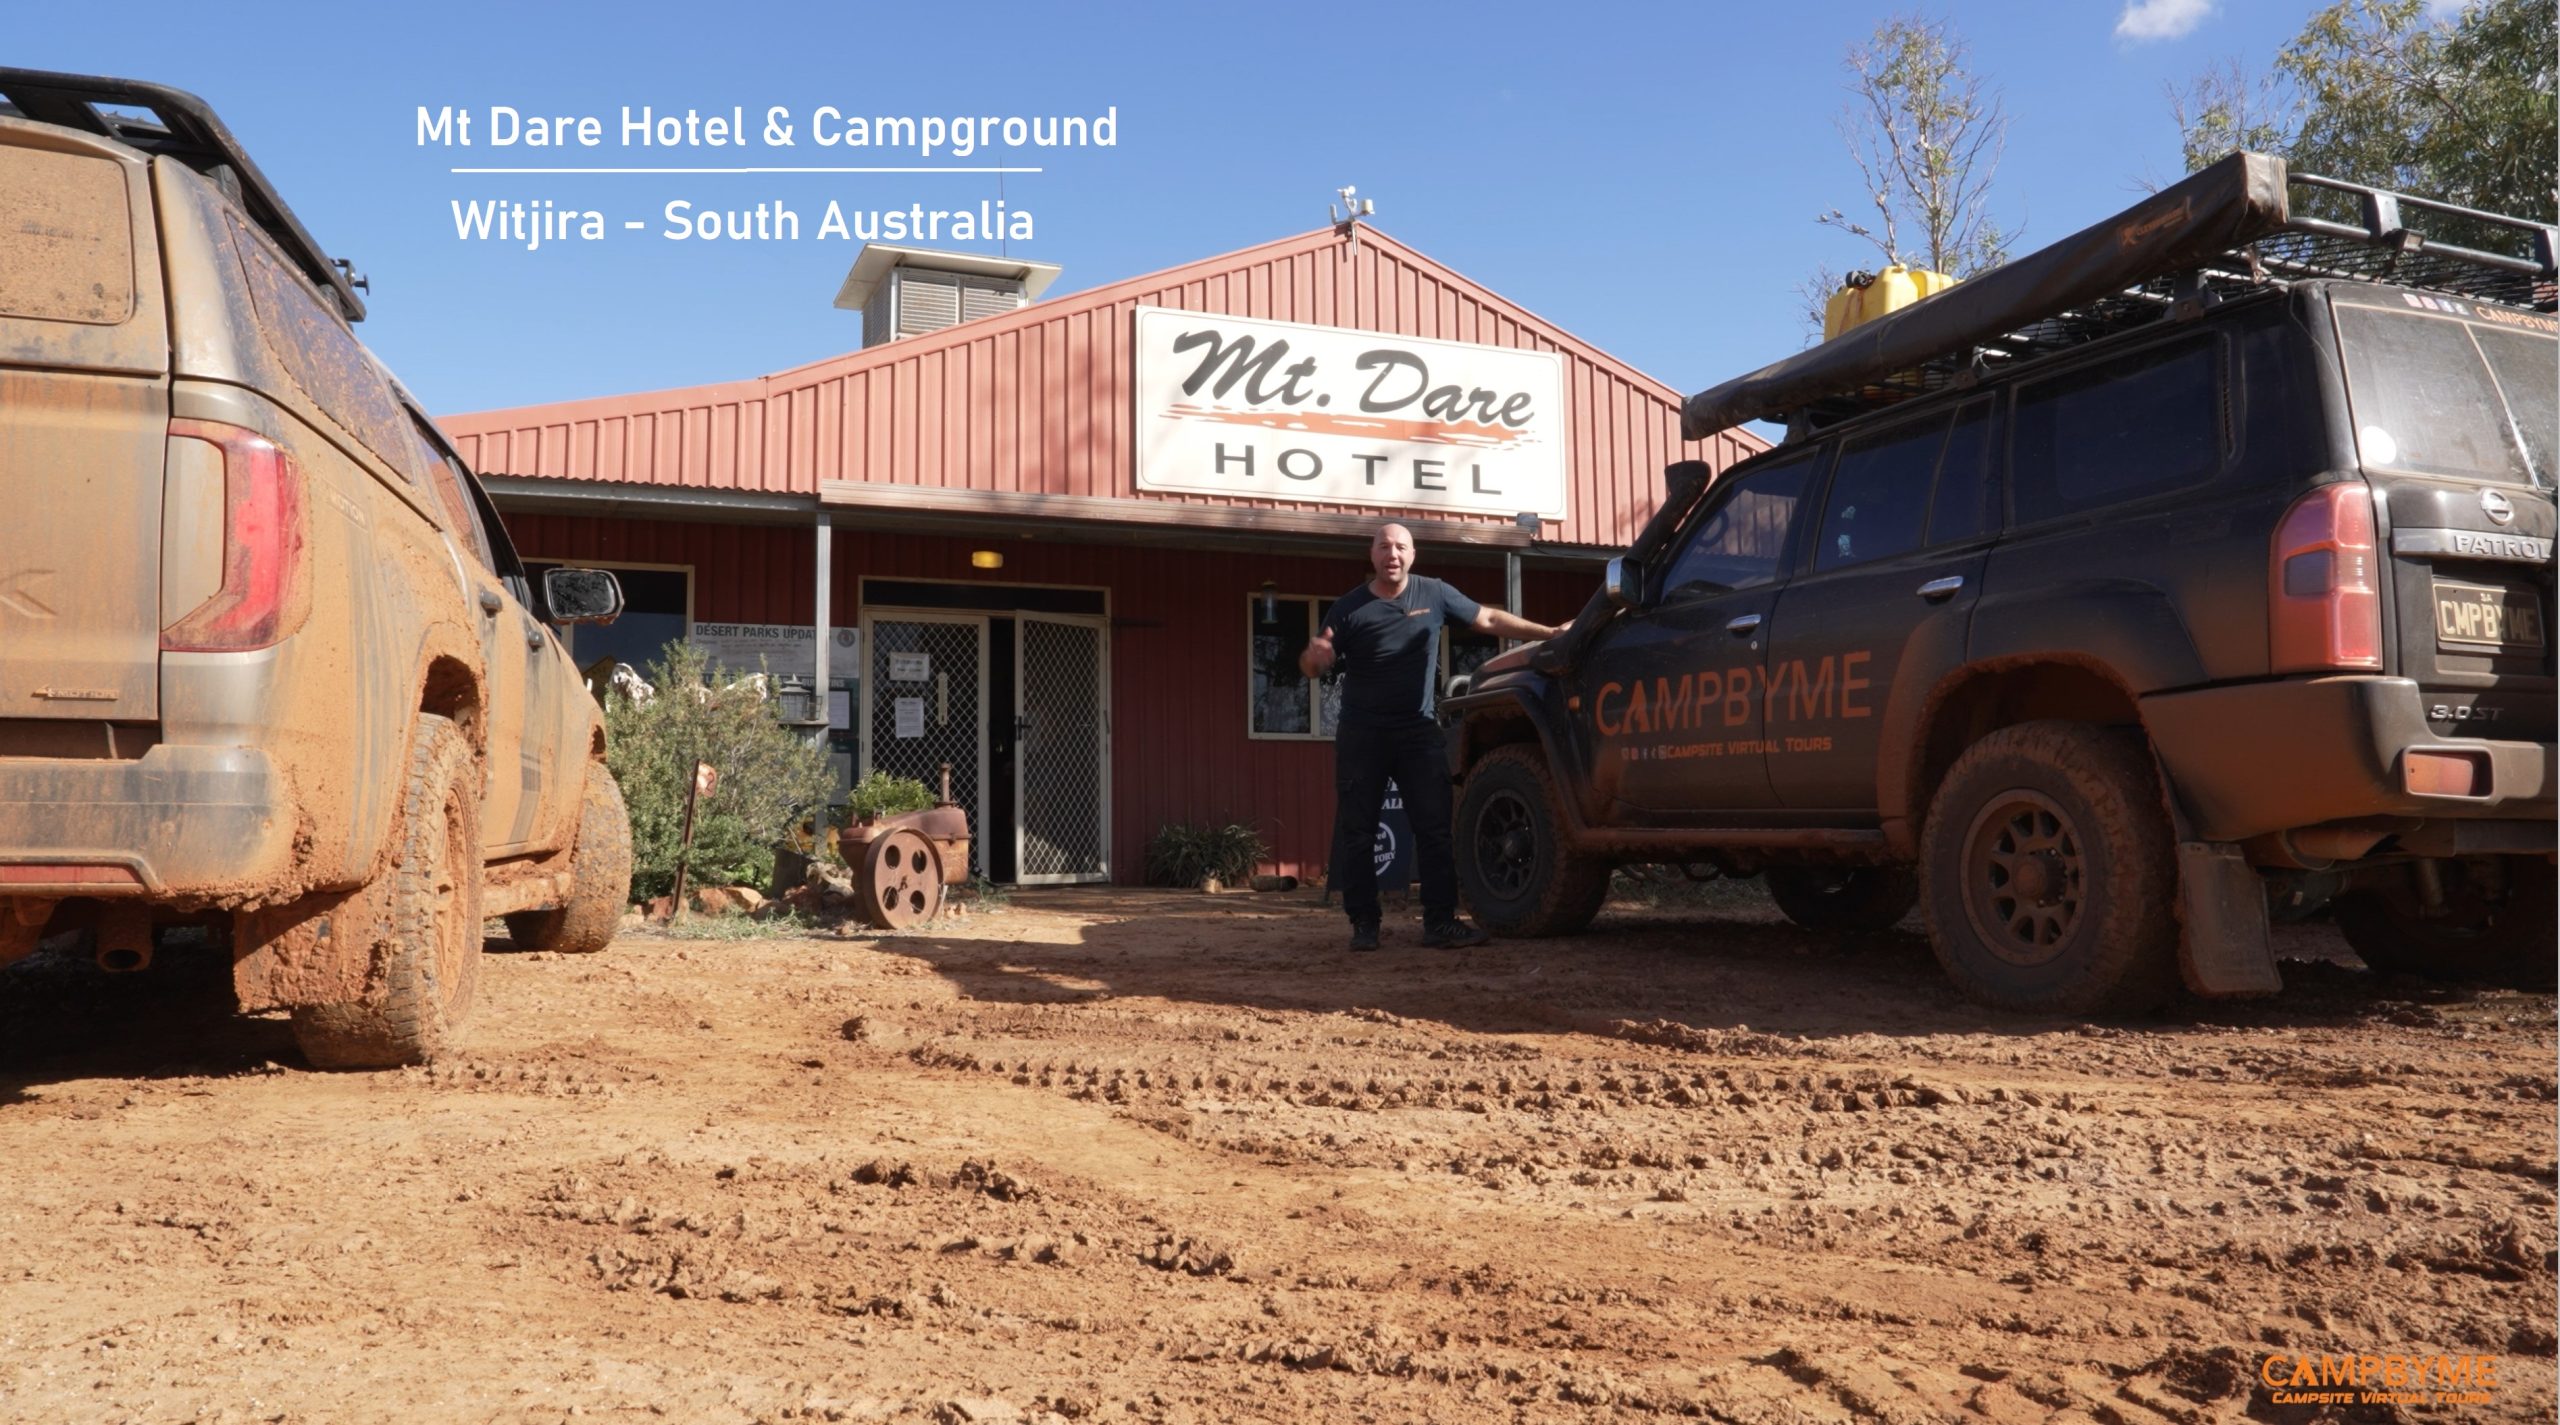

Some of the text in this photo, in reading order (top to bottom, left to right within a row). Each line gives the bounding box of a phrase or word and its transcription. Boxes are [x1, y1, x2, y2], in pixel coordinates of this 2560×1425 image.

[1173, 329, 1535, 428] Mt. Dare
[1214, 442, 1502, 496] HOTEL
[2454, 535, 2551, 559] PATROL
[695, 625, 739, 637] DESERT
[743, 626, 779, 639] PARKS
[2440, 600, 2538, 641] CMPBYME
[1595, 651, 1872, 737] CAMPBYME
[1667, 736, 1833, 759] CAMPSITE VIRTUAL TOURS
